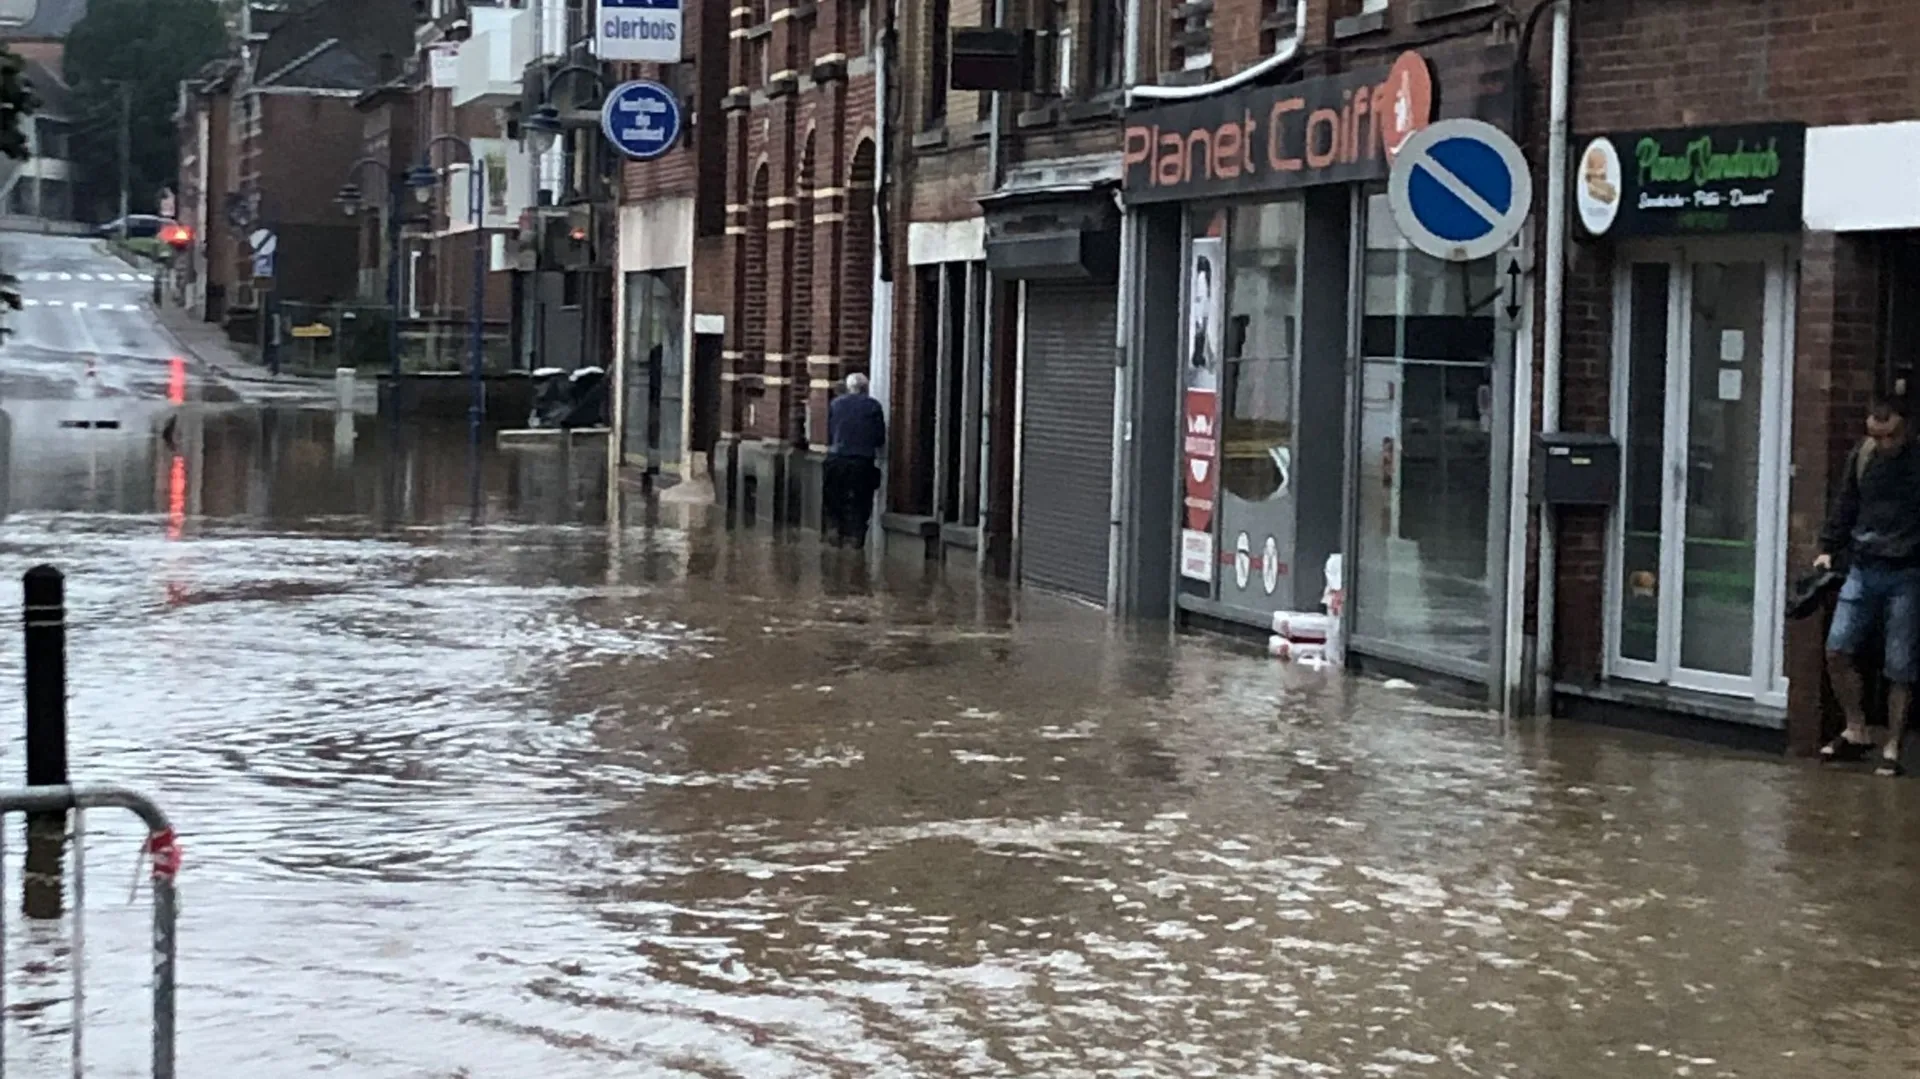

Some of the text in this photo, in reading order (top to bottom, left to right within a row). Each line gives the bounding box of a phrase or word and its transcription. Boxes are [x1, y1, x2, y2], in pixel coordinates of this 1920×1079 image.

[603, 15, 677, 41] clerbois
[1123, 108, 1256, 188] Planet
[1693, 134, 1780, 187] Sandwich
